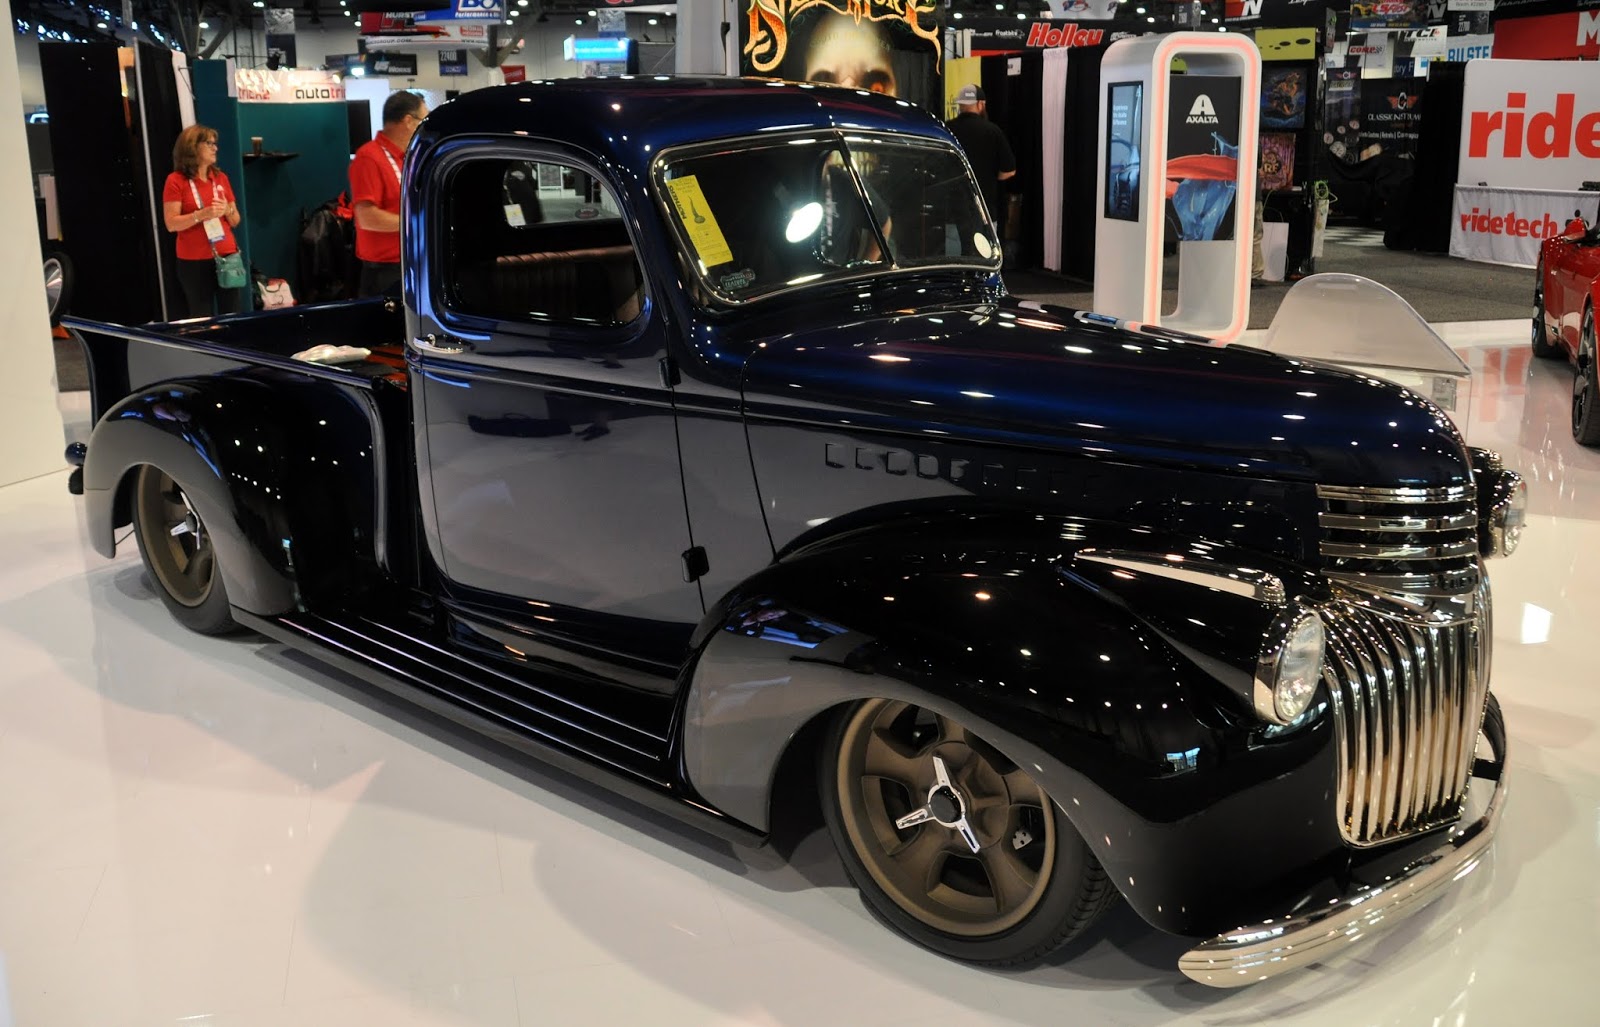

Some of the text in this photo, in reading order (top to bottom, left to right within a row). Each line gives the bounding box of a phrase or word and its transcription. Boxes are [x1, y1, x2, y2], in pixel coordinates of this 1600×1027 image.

[1026, 22, 1104, 48] Holley
[1185, 116, 1219, 124] AXALTA
[1468, 92, 1600, 159] ride
[1460, 207, 1558, 239] ridetech
